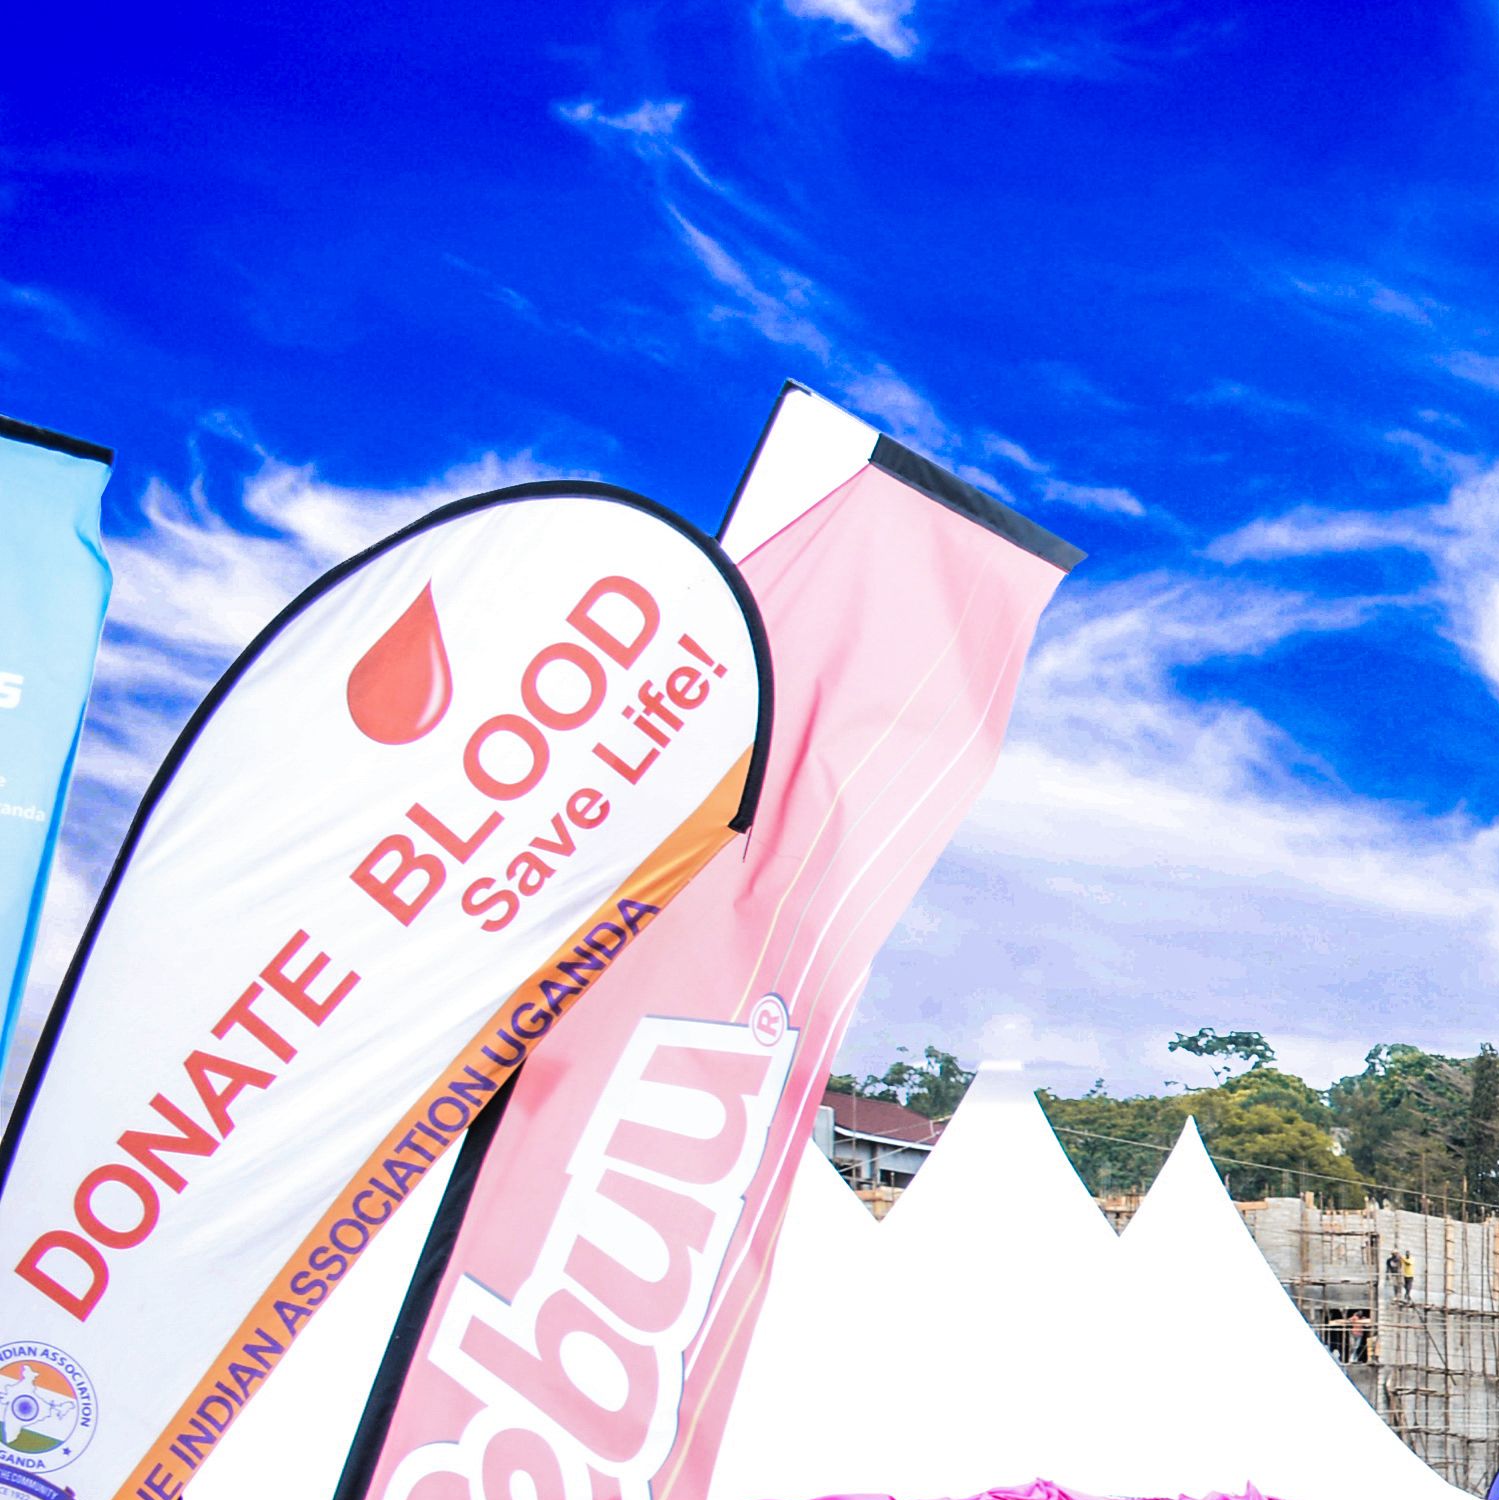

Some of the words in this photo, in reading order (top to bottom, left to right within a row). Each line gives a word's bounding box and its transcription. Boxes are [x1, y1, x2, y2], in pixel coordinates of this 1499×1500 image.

[14, 929, 361, 1322] DONATE
[349, 575, 661, 927] BLOOD
[461, 788, 612, 932] Save
[592, 633, 727, 786] Life!
[41, 1350, 91, 1427] ASSOCIATION
[170, 1325, 285, 1471] INDIAN
[271, 1063, 497, 1332] ASSOCIATION
[484, 898, 661, 1070] UGANDA
